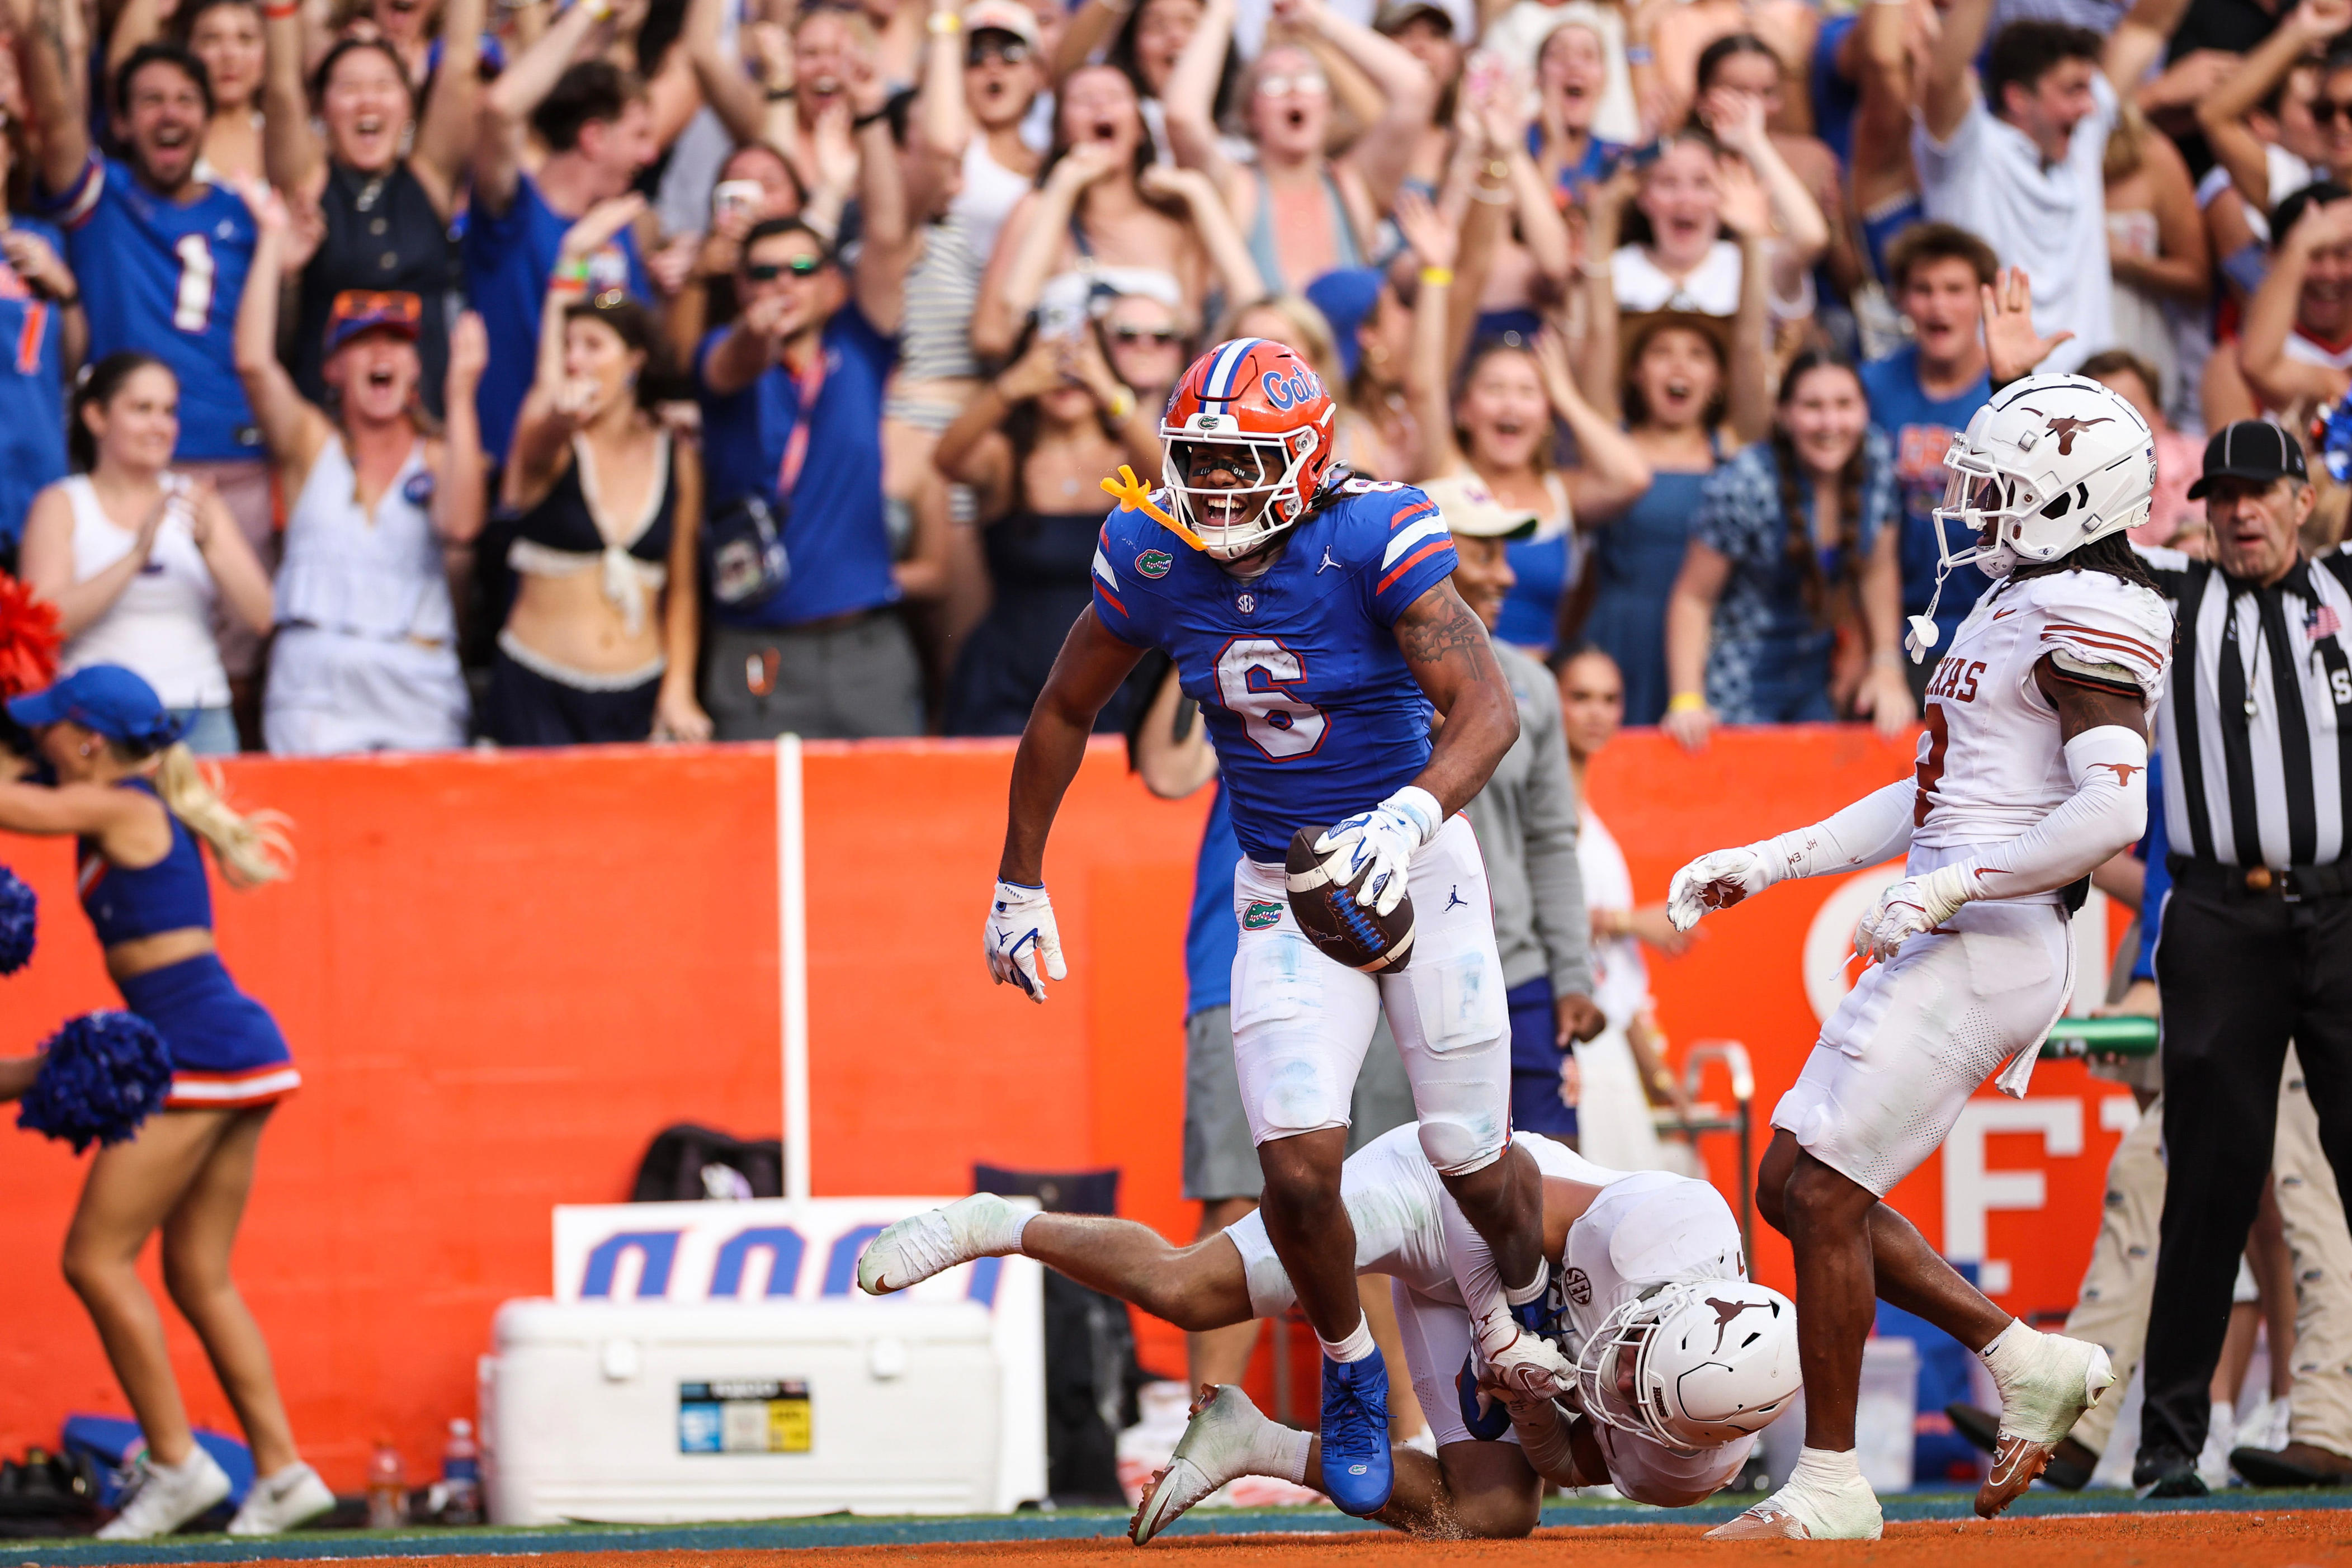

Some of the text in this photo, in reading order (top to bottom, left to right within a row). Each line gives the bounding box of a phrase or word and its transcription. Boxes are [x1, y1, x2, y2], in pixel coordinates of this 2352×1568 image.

[170, 232, 218, 336] 1
[1262, 365, 1330, 413] Gato
[1237, 594, 1255, 613] SEC
[1212, 634, 1333, 763] 6
[2330, 667, 2352, 705] S
[1566, 1269, 1591, 1305] SEC
